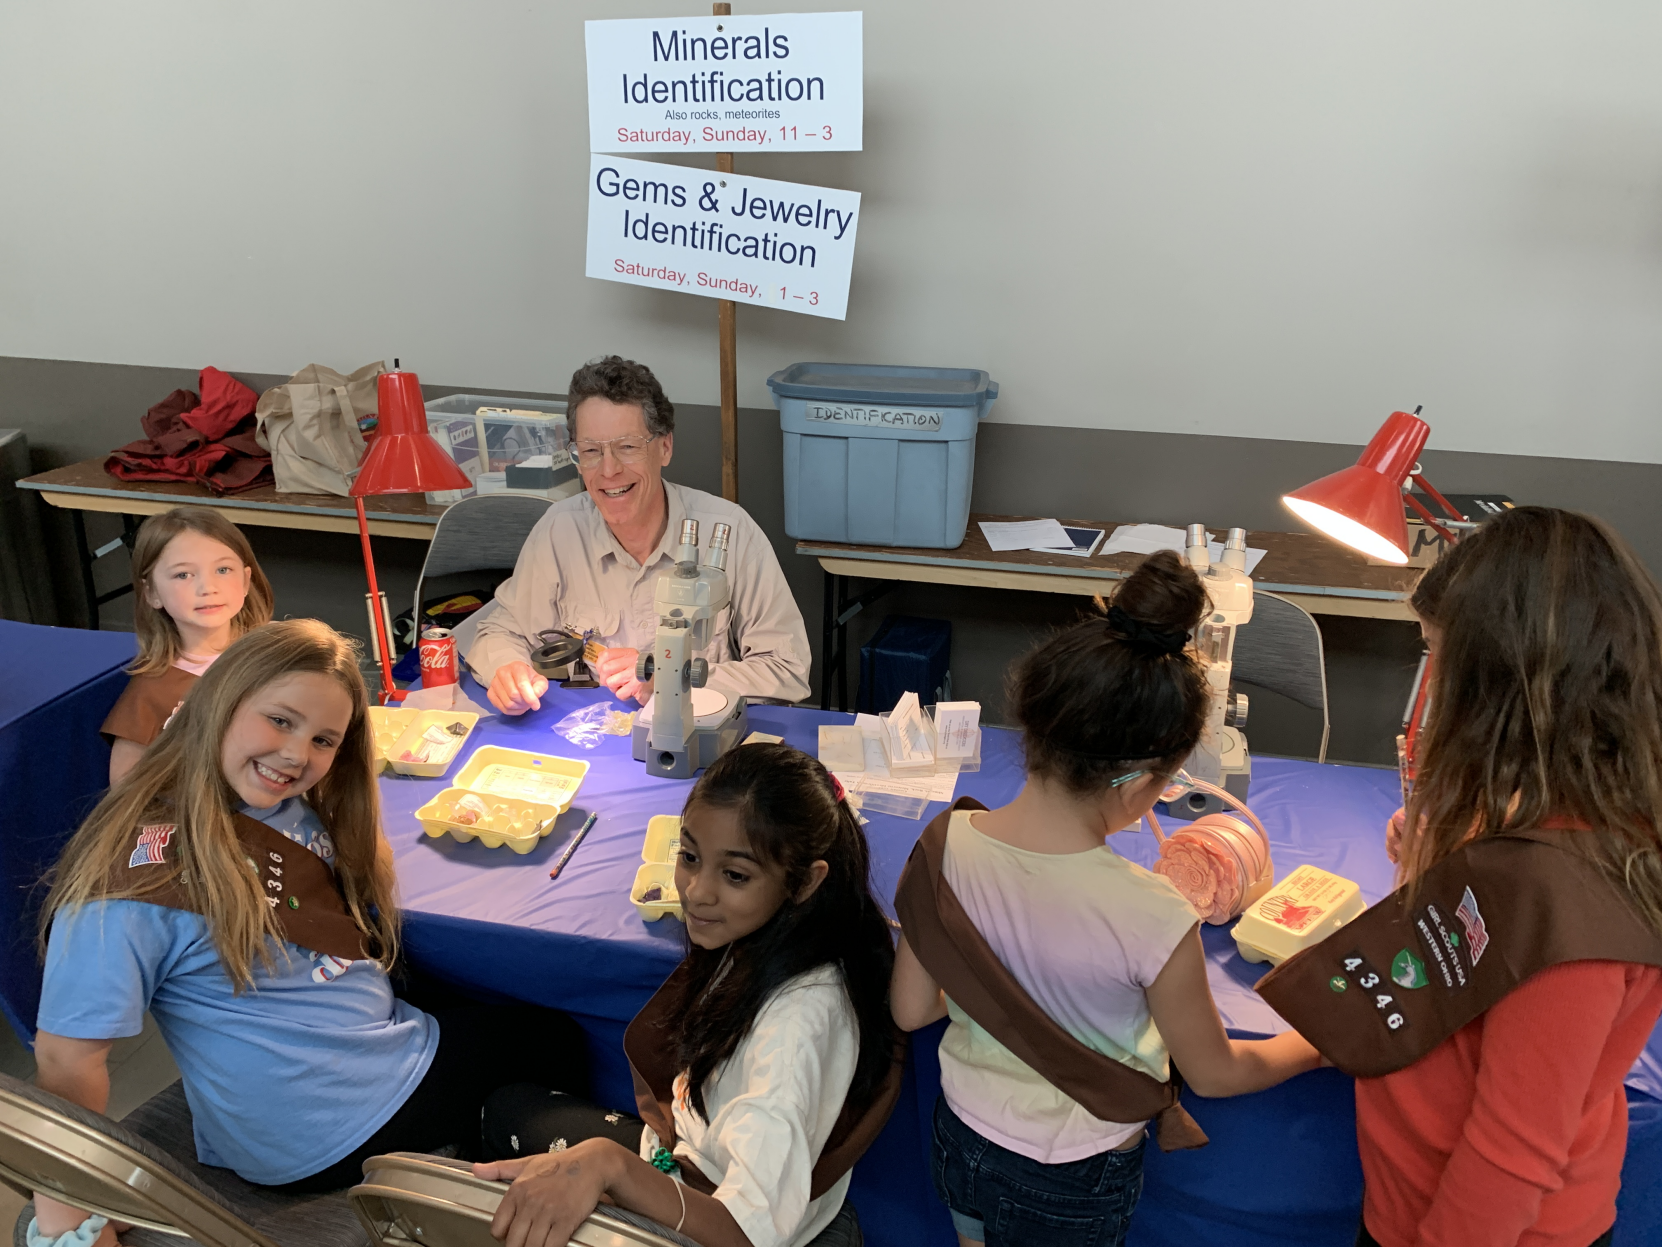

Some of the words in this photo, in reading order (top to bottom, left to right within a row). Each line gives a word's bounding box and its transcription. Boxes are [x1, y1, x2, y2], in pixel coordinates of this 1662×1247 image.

[652, 27, 790, 62] Minerals
[622, 70, 825, 104] Identification
[617, 127, 697, 146] Saturday,
[702, 126, 772, 145] Sunday,
[779, 125, 798, 141] 11
[822, 125, 833, 141] 3
[664, 109, 688, 121] Also
[690, 109, 722, 121] rocks,
[724, 108, 781, 120] meteorites
[596, 167, 687, 208] Gems
[698, 181, 720, 213] &
[731, 187, 853, 240] Jewelry
[623, 209, 817, 268] Identification
[613, 258, 691, 287] Saturday,
[697, 272, 763, 299] Sunday,
[779, 286, 787, 301] 1
[808, 291, 820, 306] 3
[813, 406, 941, 426] IDENTIFICATION
[664, 648, 672, 659] 2
[265, 851, 283, 908] 4346
[1417, 918, 1444, 962] WESTERN
[1440, 961, 1453, 987] OHIO
[1427, 904, 1441, 928] GIRL
[1439, 925, 1459, 966] SCOUTS
[1455, 965, 1466, 987] USA
[1344, 957, 1404, 1030] 4346
